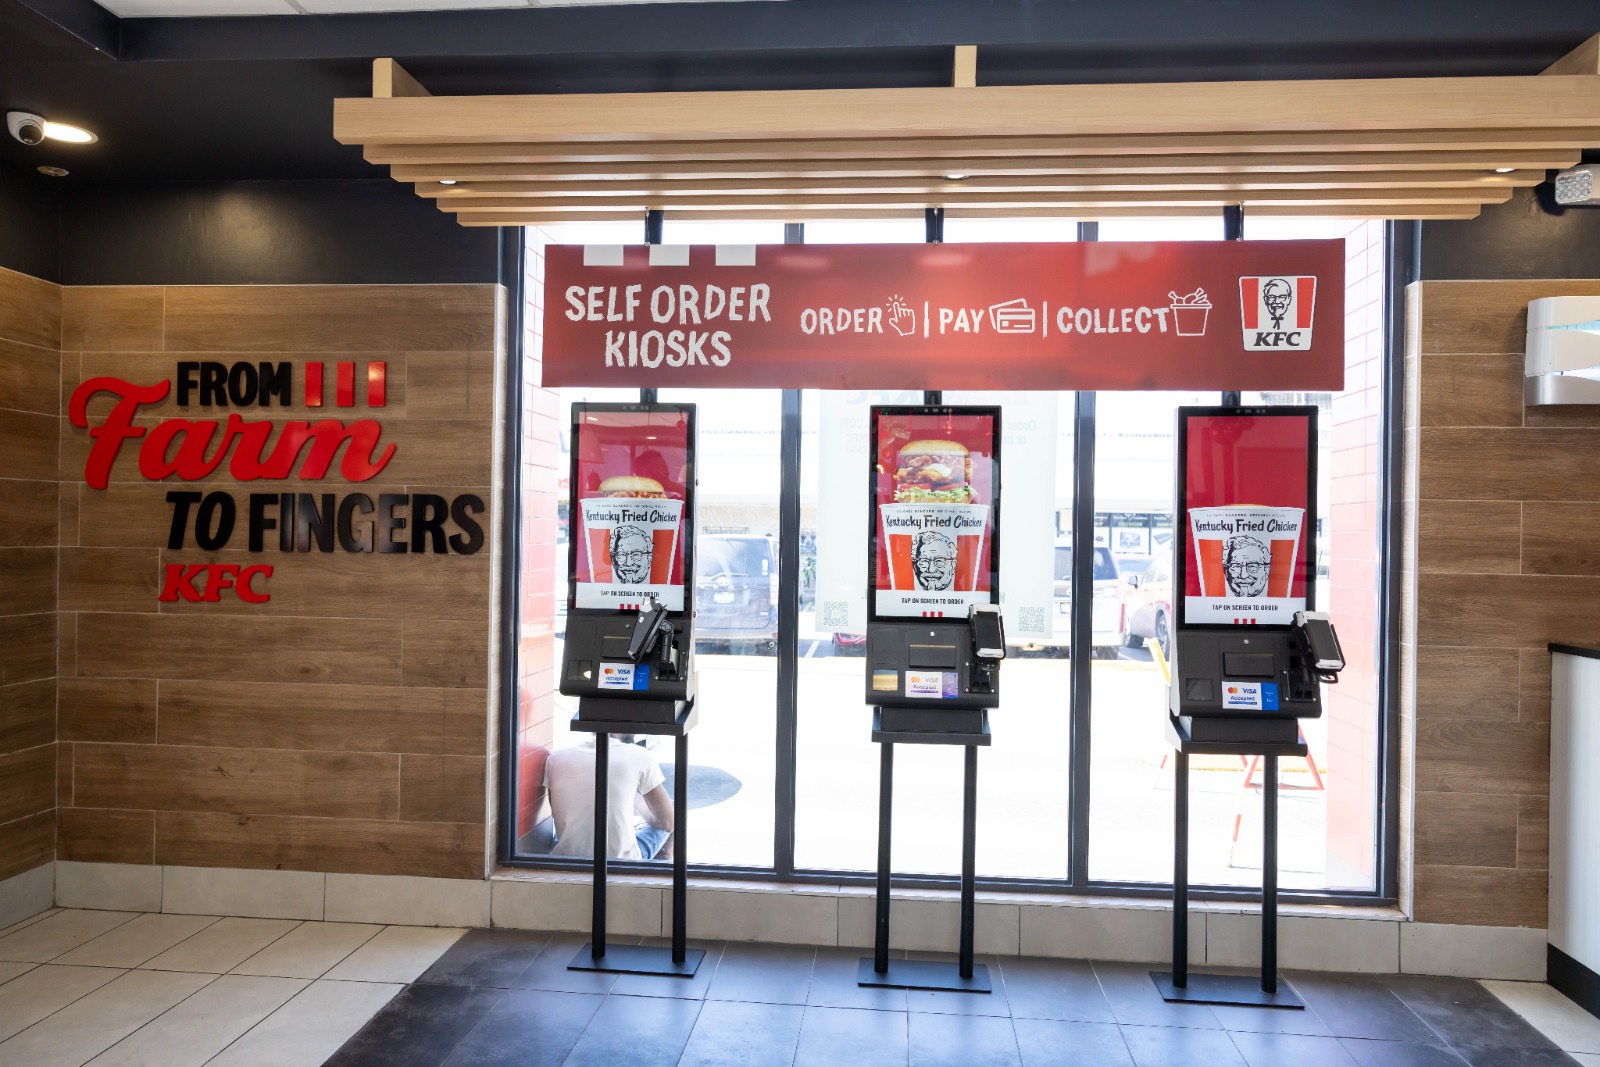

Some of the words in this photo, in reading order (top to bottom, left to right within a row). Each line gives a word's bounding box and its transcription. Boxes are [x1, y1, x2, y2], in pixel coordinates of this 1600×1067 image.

[565, 284, 642, 322] SELF
[651, 283, 772, 325] ORDER
[800, 307, 884, 336] ORDER
[939, 307, 986, 334] PAY
[1056, 307, 1170, 335] COLLECT
[604, 330, 732, 369] KIOSKS
[1253, 331, 1303, 348] KFC
[176, 361, 292, 407] FROM
[68, 376, 396, 490] Farm
[165, 490, 236, 551] TO
[248, 493, 486, 554] FINGERS
[586, 510, 620, 524] Kentucky
[621, 509, 648, 523] Fried
[886, 515, 922, 530] Kentucky
[924, 514, 951, 528] Fried
[1195, 519, 1234, 534] Kentucky
[1235, 519, 1265, 533] Fried
[158, 564, 274, 603] KFC
